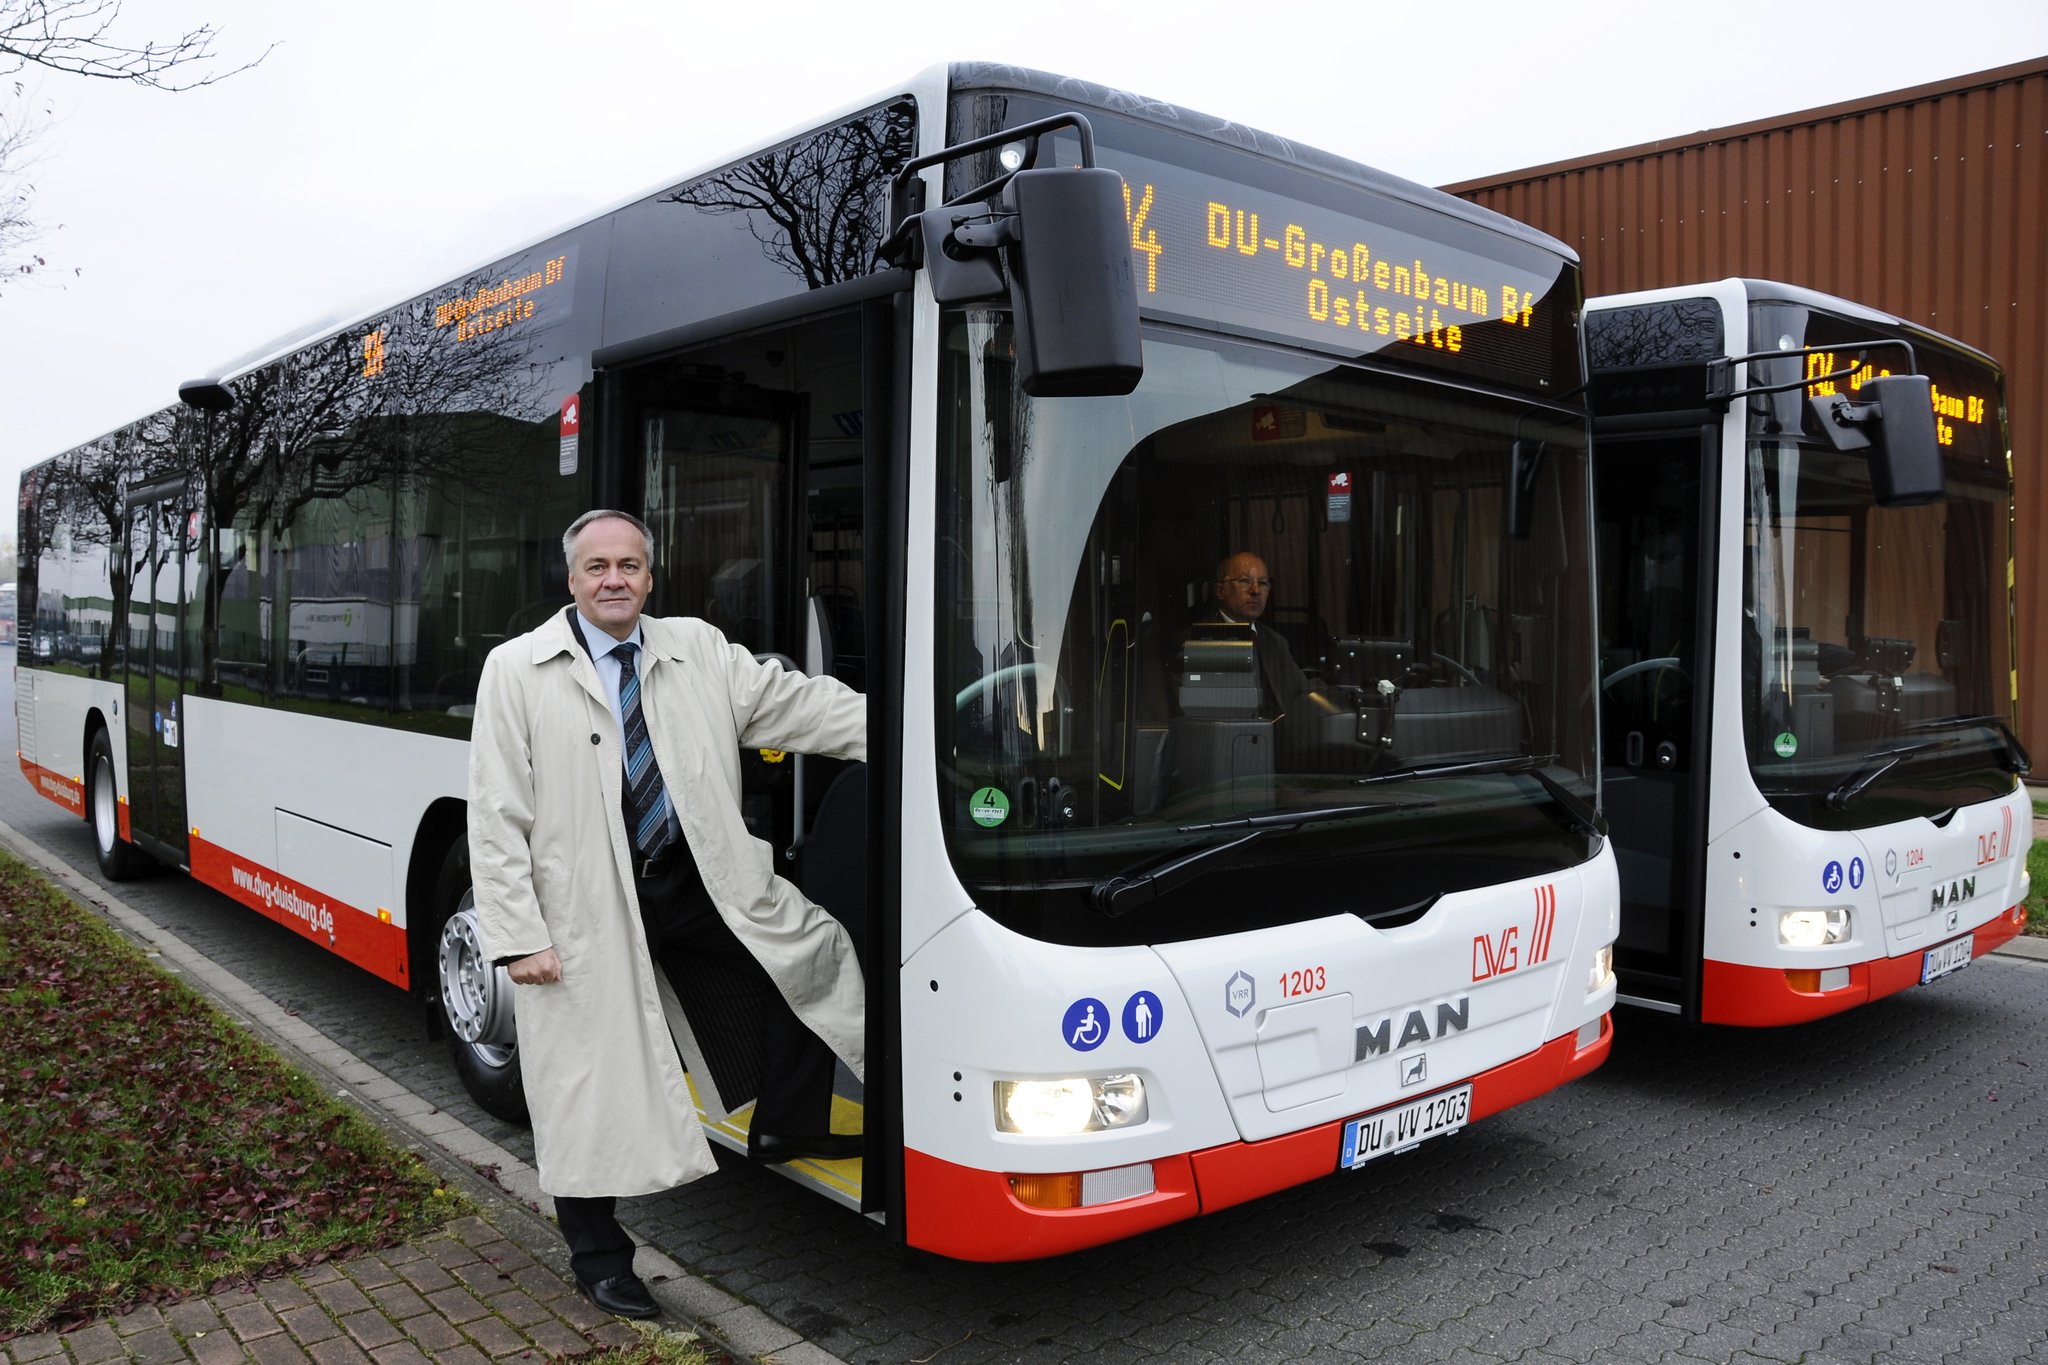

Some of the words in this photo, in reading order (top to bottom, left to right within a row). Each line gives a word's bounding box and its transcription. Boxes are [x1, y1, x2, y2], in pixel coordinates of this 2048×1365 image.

[1123, 183, 1163, 294] 4
[545, 255, 567, 285] Bf
[1206, 201, 1488, 317] DU-Großenbaum
[1501, 285, 1534, 328] Bf
[456, 297, 536, 343] Ostseite
[1307, 278, 1463, 353] Ostseite
[1967, 394, 1985, 424] Bf
[1783, 733, 1790, 745] 4
[984, 789, 995, 807] 4
[1906, 848, 1925, 867] 1204
[1977, 831, 1997, 866] DVG
[231, 865, 334, 934] www.dvg-duisburg.de
[1930, 875, 1976, 912] MAN
[1472, 926, 1519, 982] DVG
[1232, 988, 1249, 1000] VRR
[1279, 966, 1326, 998] 1203
[1355, 996, 1469, 1062] MAN
[1345, 1147, 1352, 1158] D
[1357, 1119, 1384, 1156] DU
[1397, 1106, 1422, 1142] VV
[1423, 1091, 1468, 1132] 1203
